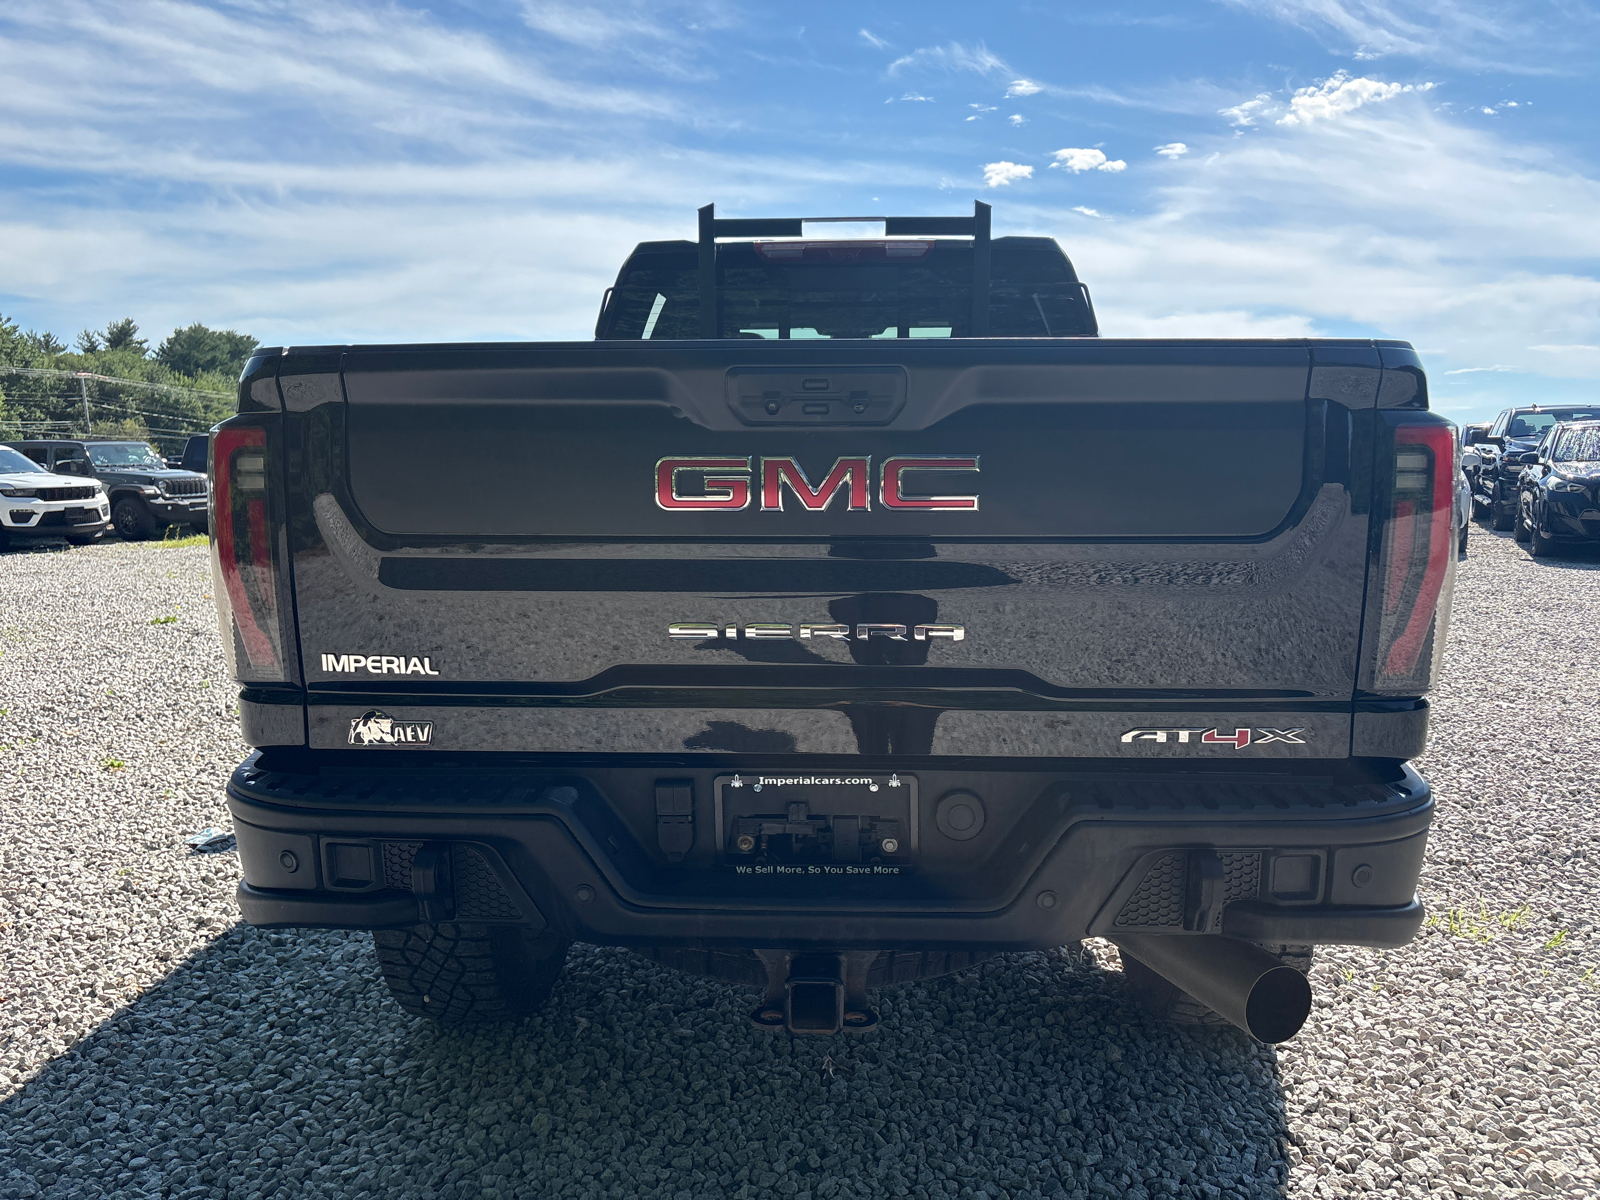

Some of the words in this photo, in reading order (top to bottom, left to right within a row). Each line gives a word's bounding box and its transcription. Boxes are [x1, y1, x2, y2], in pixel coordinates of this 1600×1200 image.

[654, 454, 981, 512] GMC
[668, 623, 965, 641] SIERRA
[321, 653, 440, 676] IMPERIAL
[394, 723, 431, 742] AEV
[1120, 727, 1307, 750] AT4X
[758, 776, 873, 787] Imperialcars.com
[736, 865, 753, 874] We
[755, 865, 774, 874] Sell
[776, 865, 806, 875] More,
[807, 865, 821, 874] So
[823, 865, 844, 874] You
[845, 865, 871, 874] Save
[873, 865, 900, 874] More
